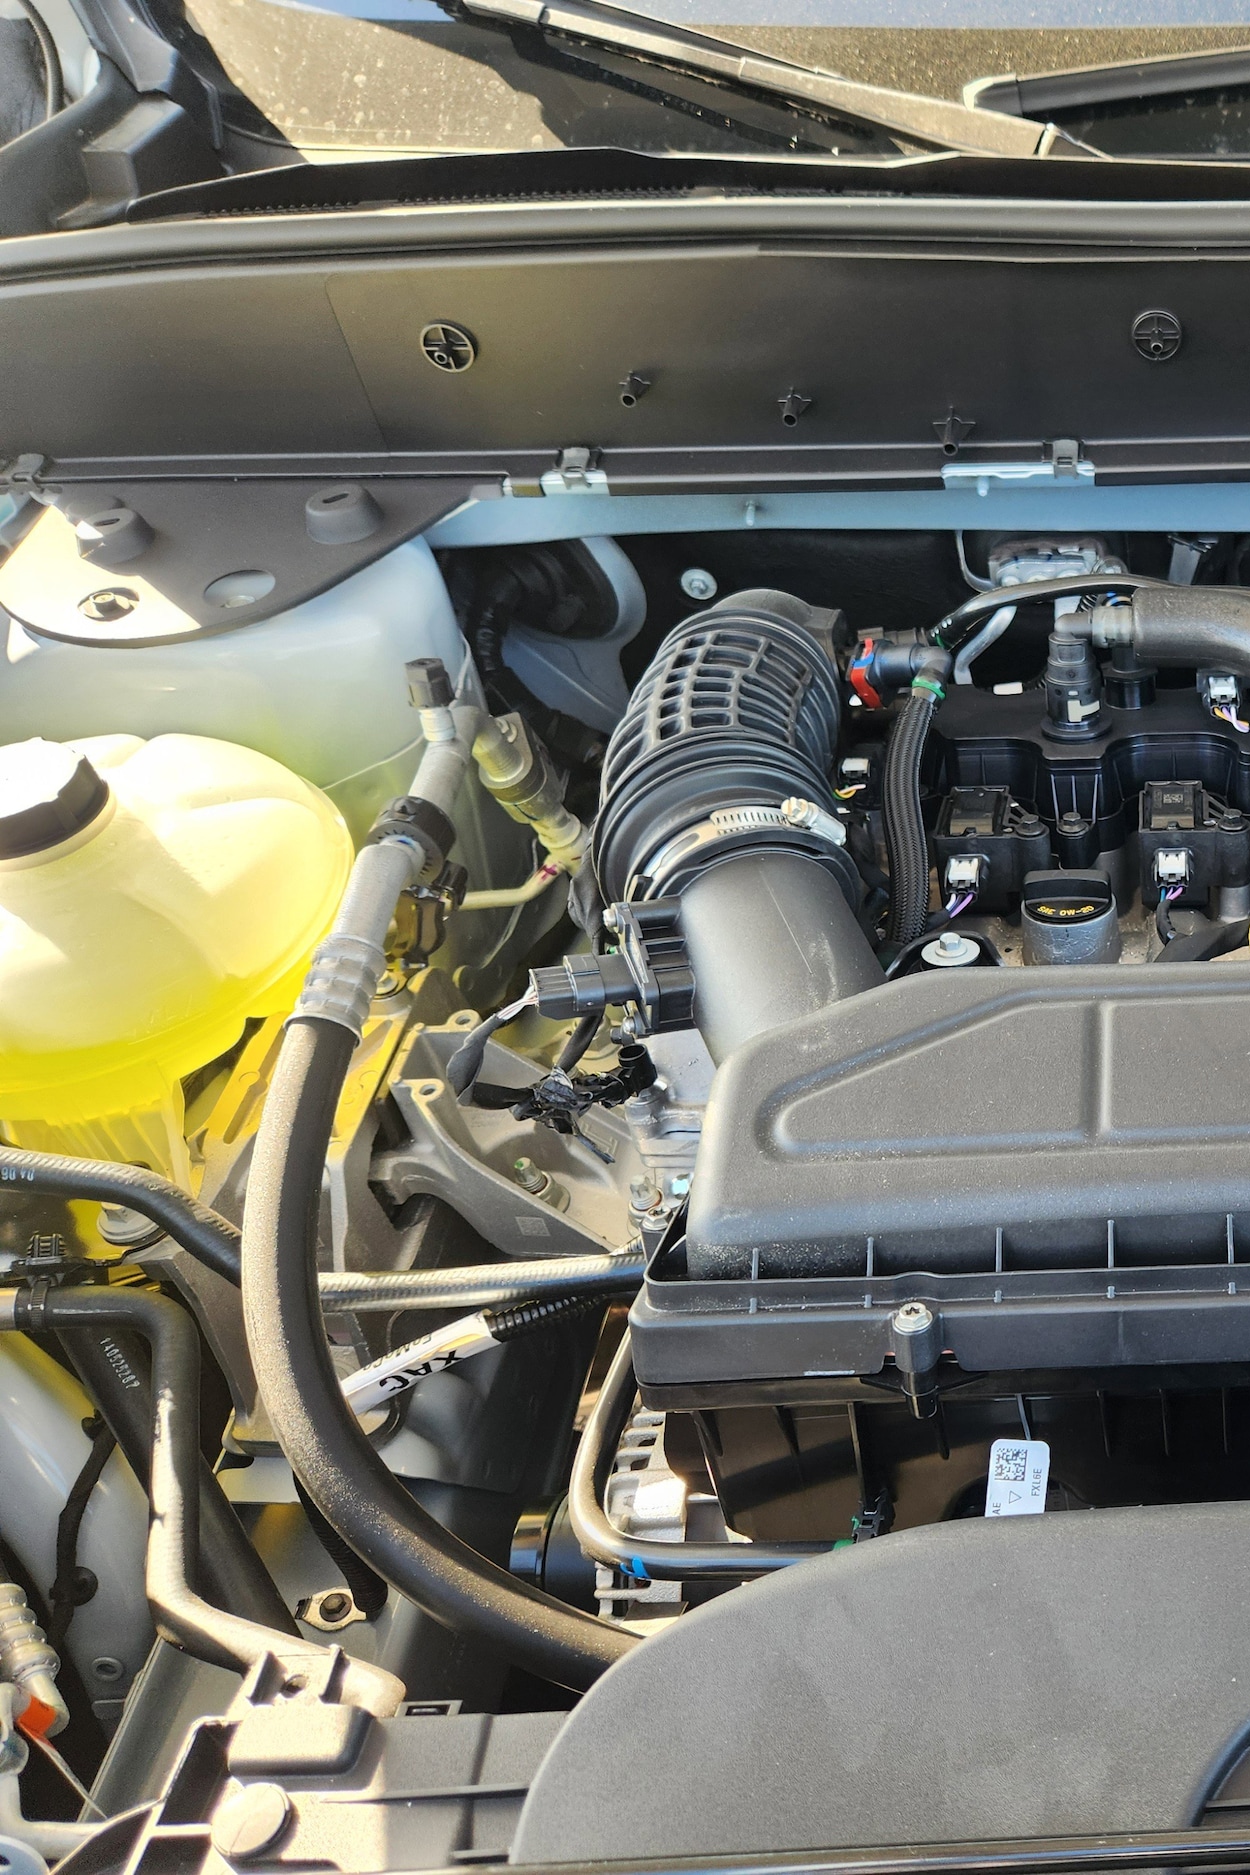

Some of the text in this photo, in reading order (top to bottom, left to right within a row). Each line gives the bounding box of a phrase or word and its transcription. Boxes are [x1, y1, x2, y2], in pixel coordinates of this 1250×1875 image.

[1037, 905, 1095, 916] SAE 0W-20
[379, 1350, 464, 1392] XAC
[1031, 1468, 1043, 1497] FXL6E
[992, 1502, 1002, 1515] AE
